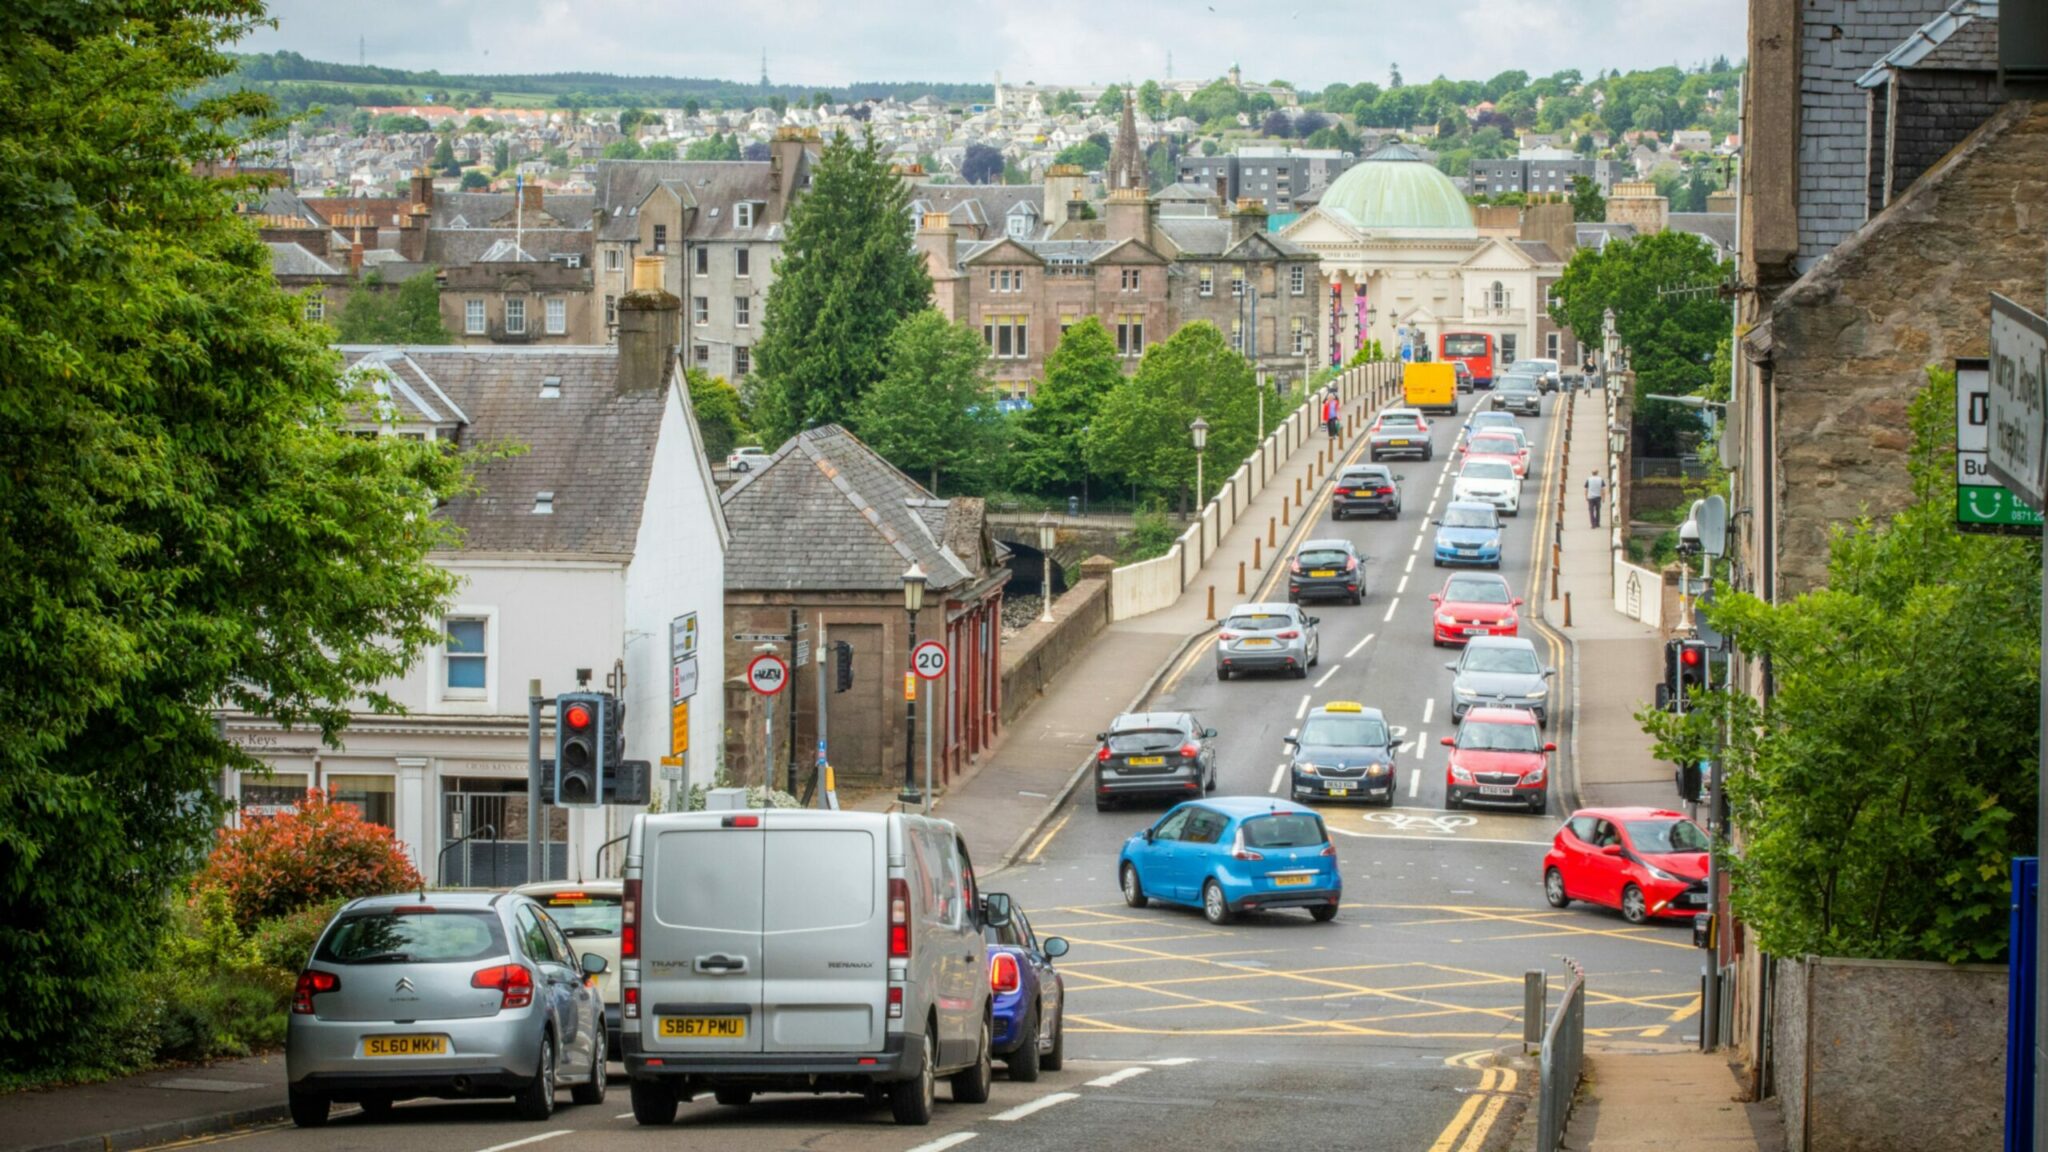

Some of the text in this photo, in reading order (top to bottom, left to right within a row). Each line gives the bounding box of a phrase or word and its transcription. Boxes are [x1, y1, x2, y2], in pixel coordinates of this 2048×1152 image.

[1964, 459, 1988, 476] Bu
[918, 653, 944, 669] 20
[248, 733, 278, 749] Keys
[650, 960, 689, 968] TRAFIC
[828, 961, 874, 969] RENAULT
[666, 1019, 738, 1035] SB67 PMU
[371, 1038, 409, 1053] SL60
